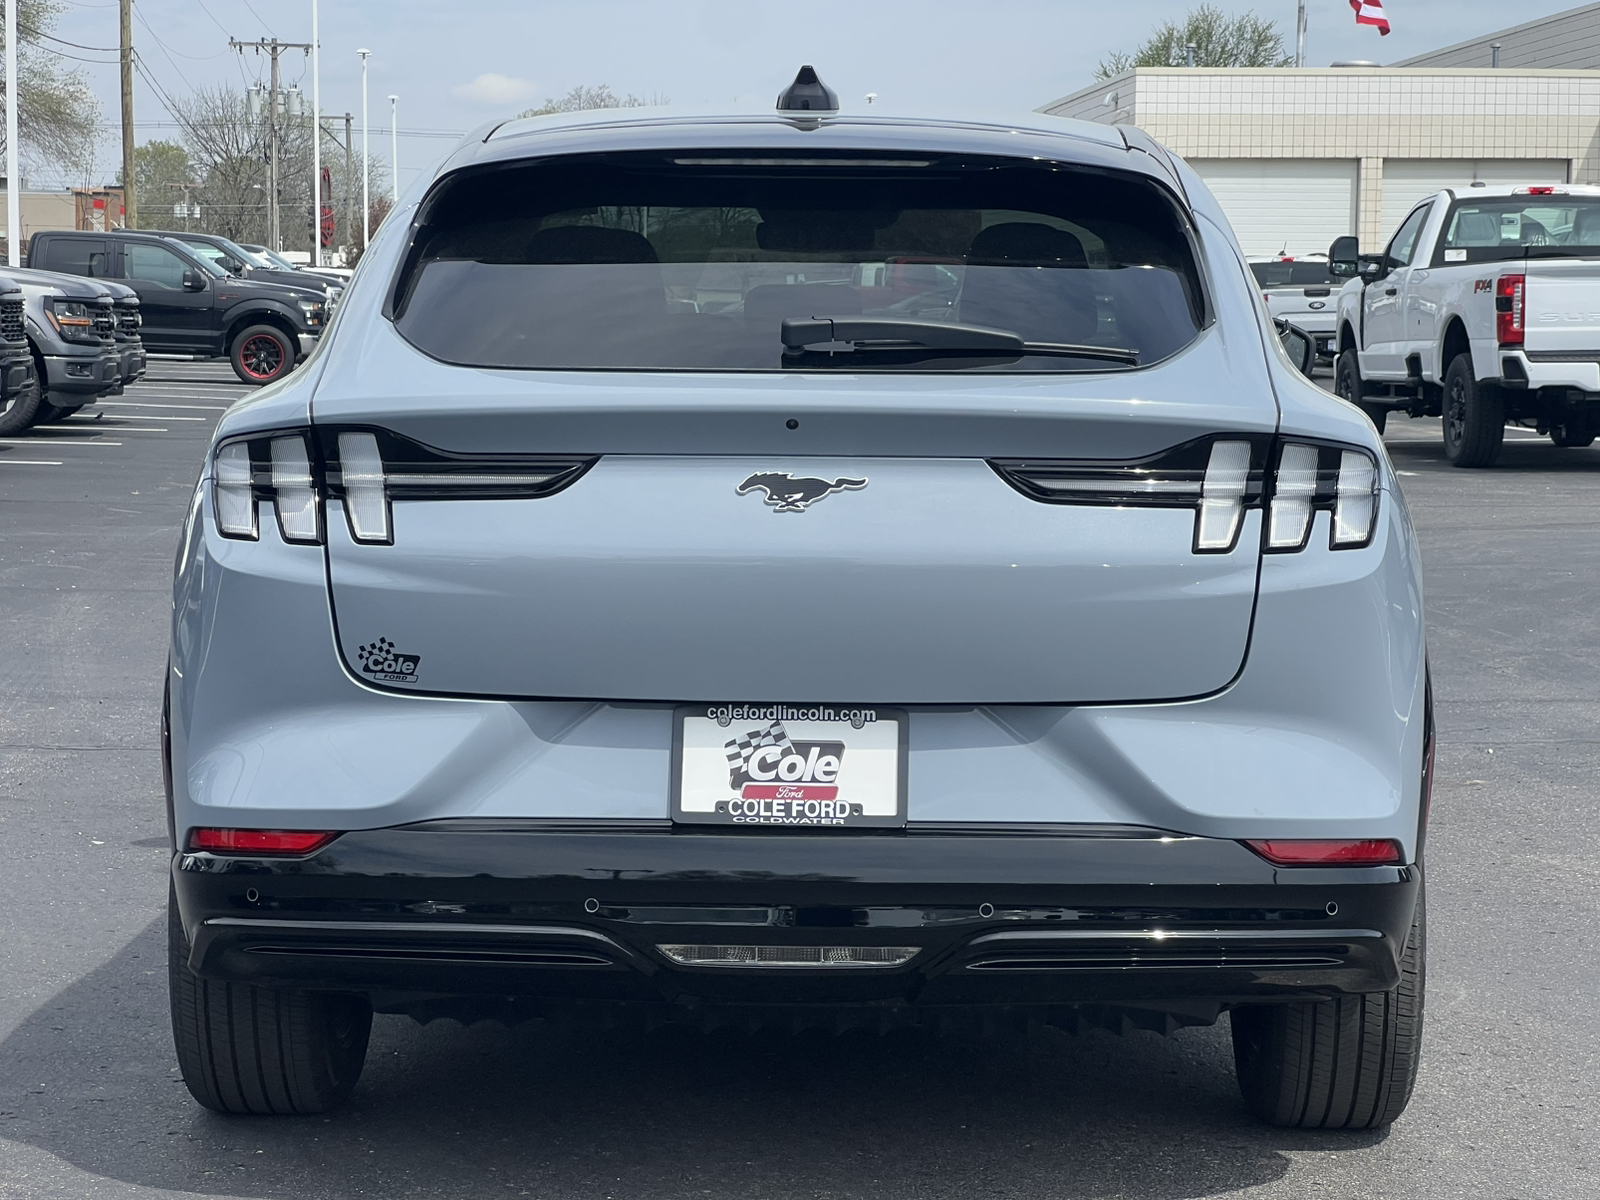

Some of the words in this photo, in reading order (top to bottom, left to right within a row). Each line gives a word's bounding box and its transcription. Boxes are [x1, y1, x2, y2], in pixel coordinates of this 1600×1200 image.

[367, 654, 415, 673] Cole
[707, 704, 877, 721] colefordlincoln.com
[747, 745, 840, 782] Cole
[776, 786, 804, 798] Ford
[728, 799, 785, 816] COLE
[792, 800, 851, 818] FORD
[732, 816, 845, 825] COLDWATER
